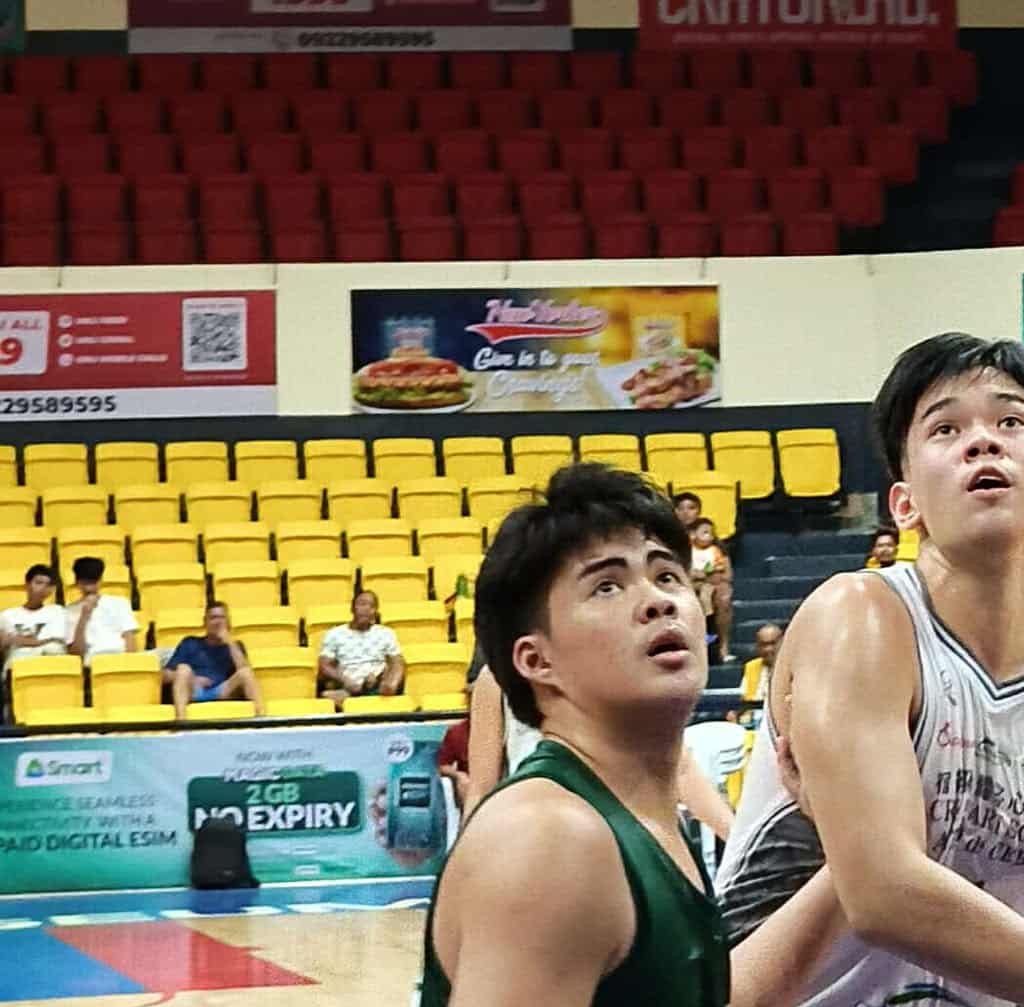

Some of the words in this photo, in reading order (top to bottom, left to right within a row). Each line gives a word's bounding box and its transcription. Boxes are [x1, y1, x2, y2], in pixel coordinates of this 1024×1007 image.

[47, 759, 103, 776] Smart
[246, 785, 261, 804] 2
[264, 782, 300, 804] GB
[247, 800, 356, 831] EXPIRY
[46, 831, 126, 852] DIGITAL
[130, 829, 178, 849] ESIM
